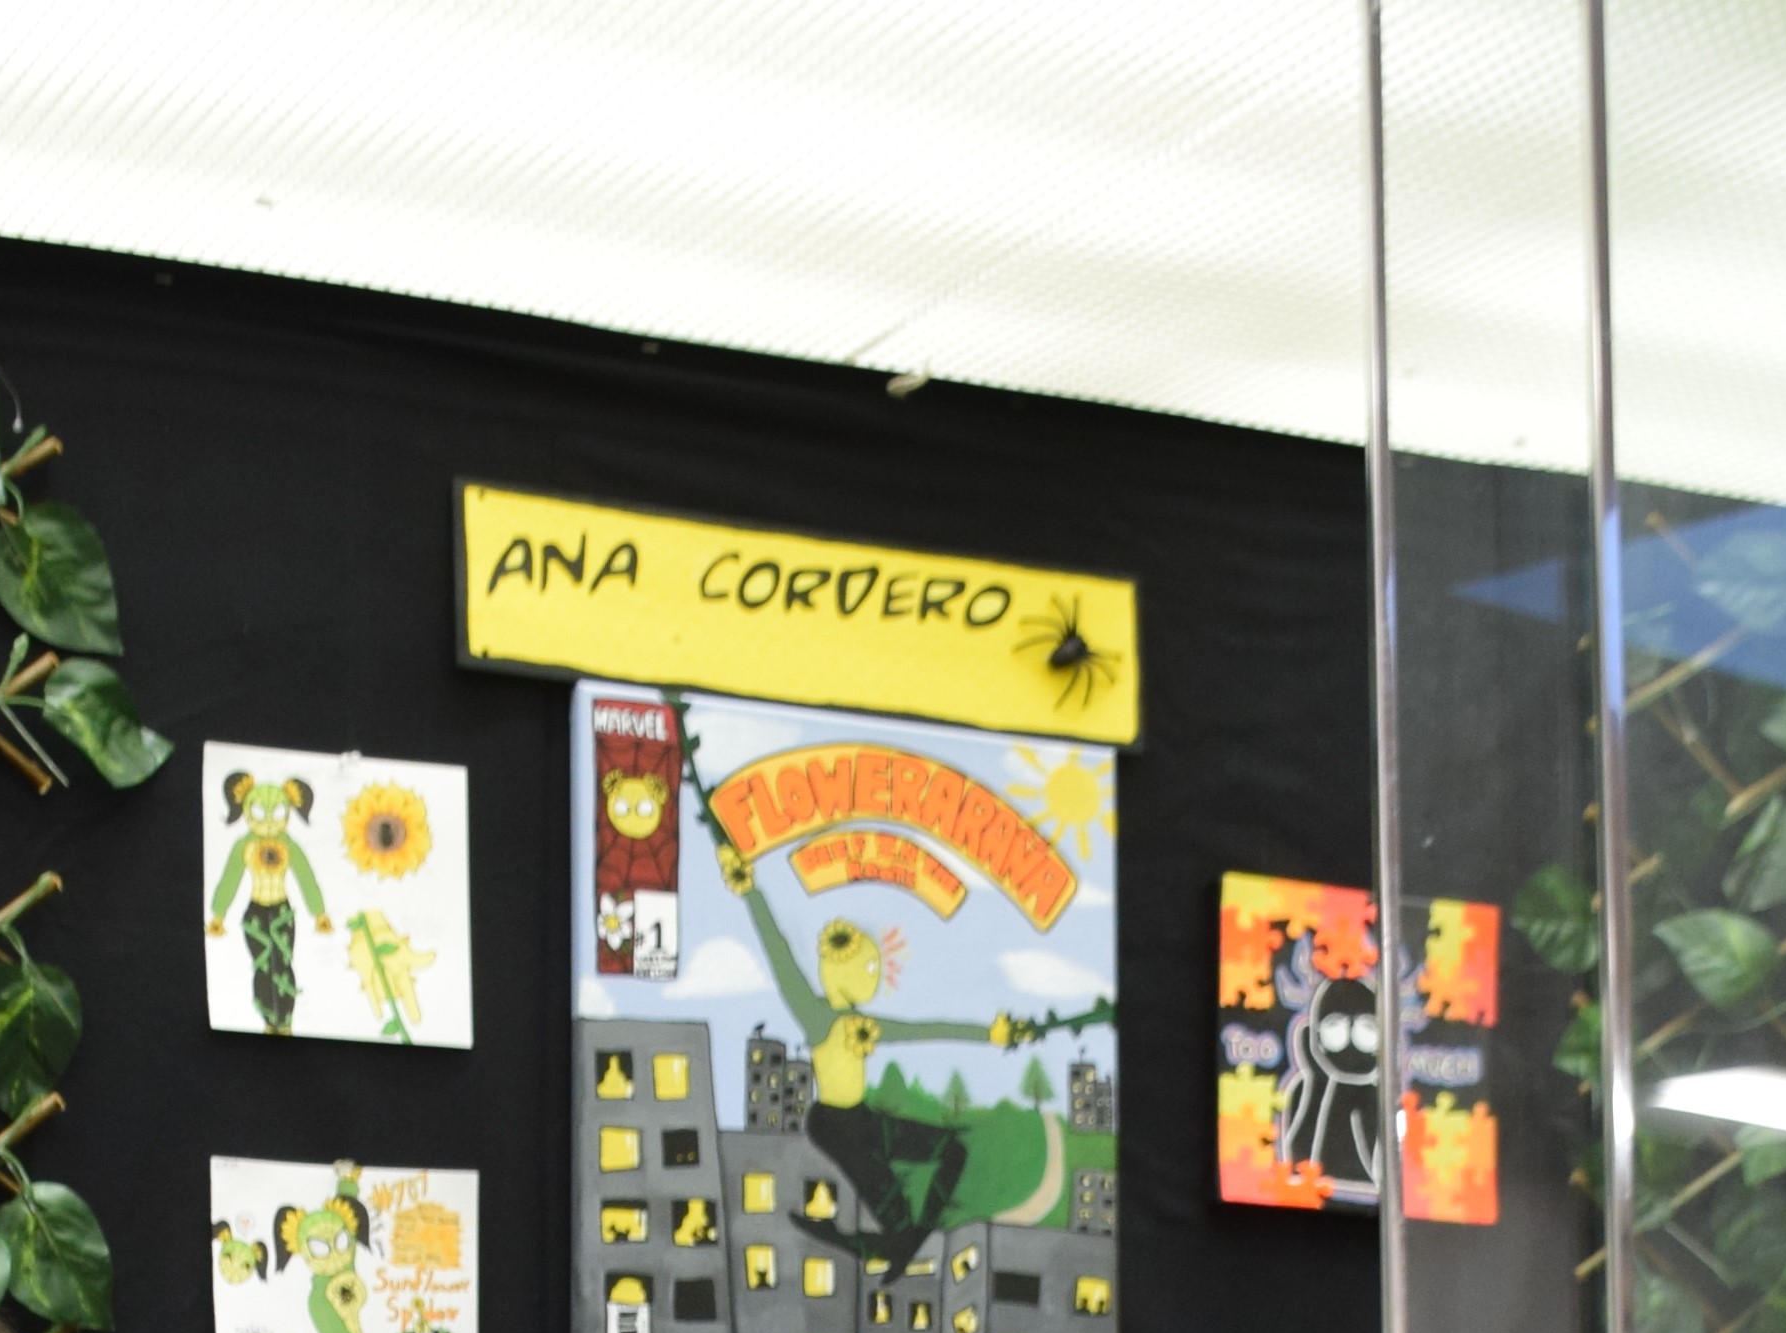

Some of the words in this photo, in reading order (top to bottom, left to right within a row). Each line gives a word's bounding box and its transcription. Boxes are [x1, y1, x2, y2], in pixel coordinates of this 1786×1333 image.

[488, 533, 639, 595] ANA
[698, 551, 1013, 629] CORDERO
[592, 705, 668, 742] MARVEL
[387, 1296, 458, 1333] Spder
